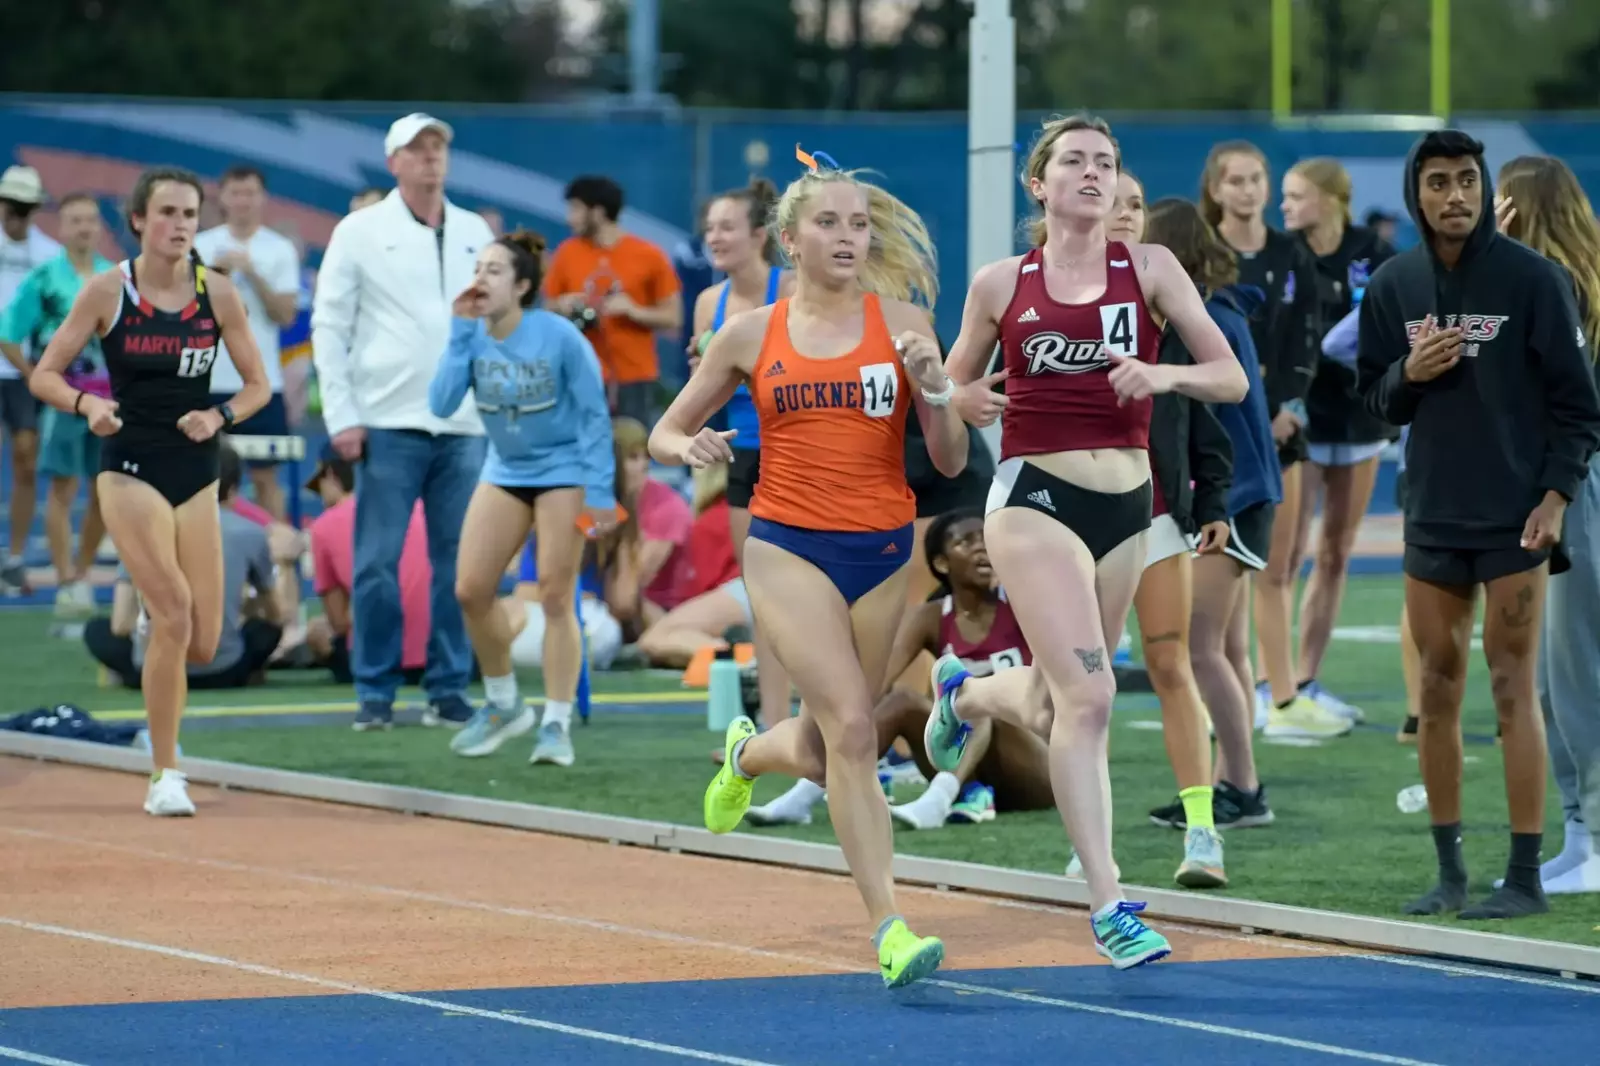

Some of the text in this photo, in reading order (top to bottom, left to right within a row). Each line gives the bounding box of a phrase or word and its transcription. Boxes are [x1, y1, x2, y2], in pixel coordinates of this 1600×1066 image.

[1108, 306, 1133, 353] 4
[185, 350, 210, 375] 15
[1021, 331, 1113, 376] RIDE
[773, 381, 866, 415] BUCKNE
[865, 374, 895, 411] 14
